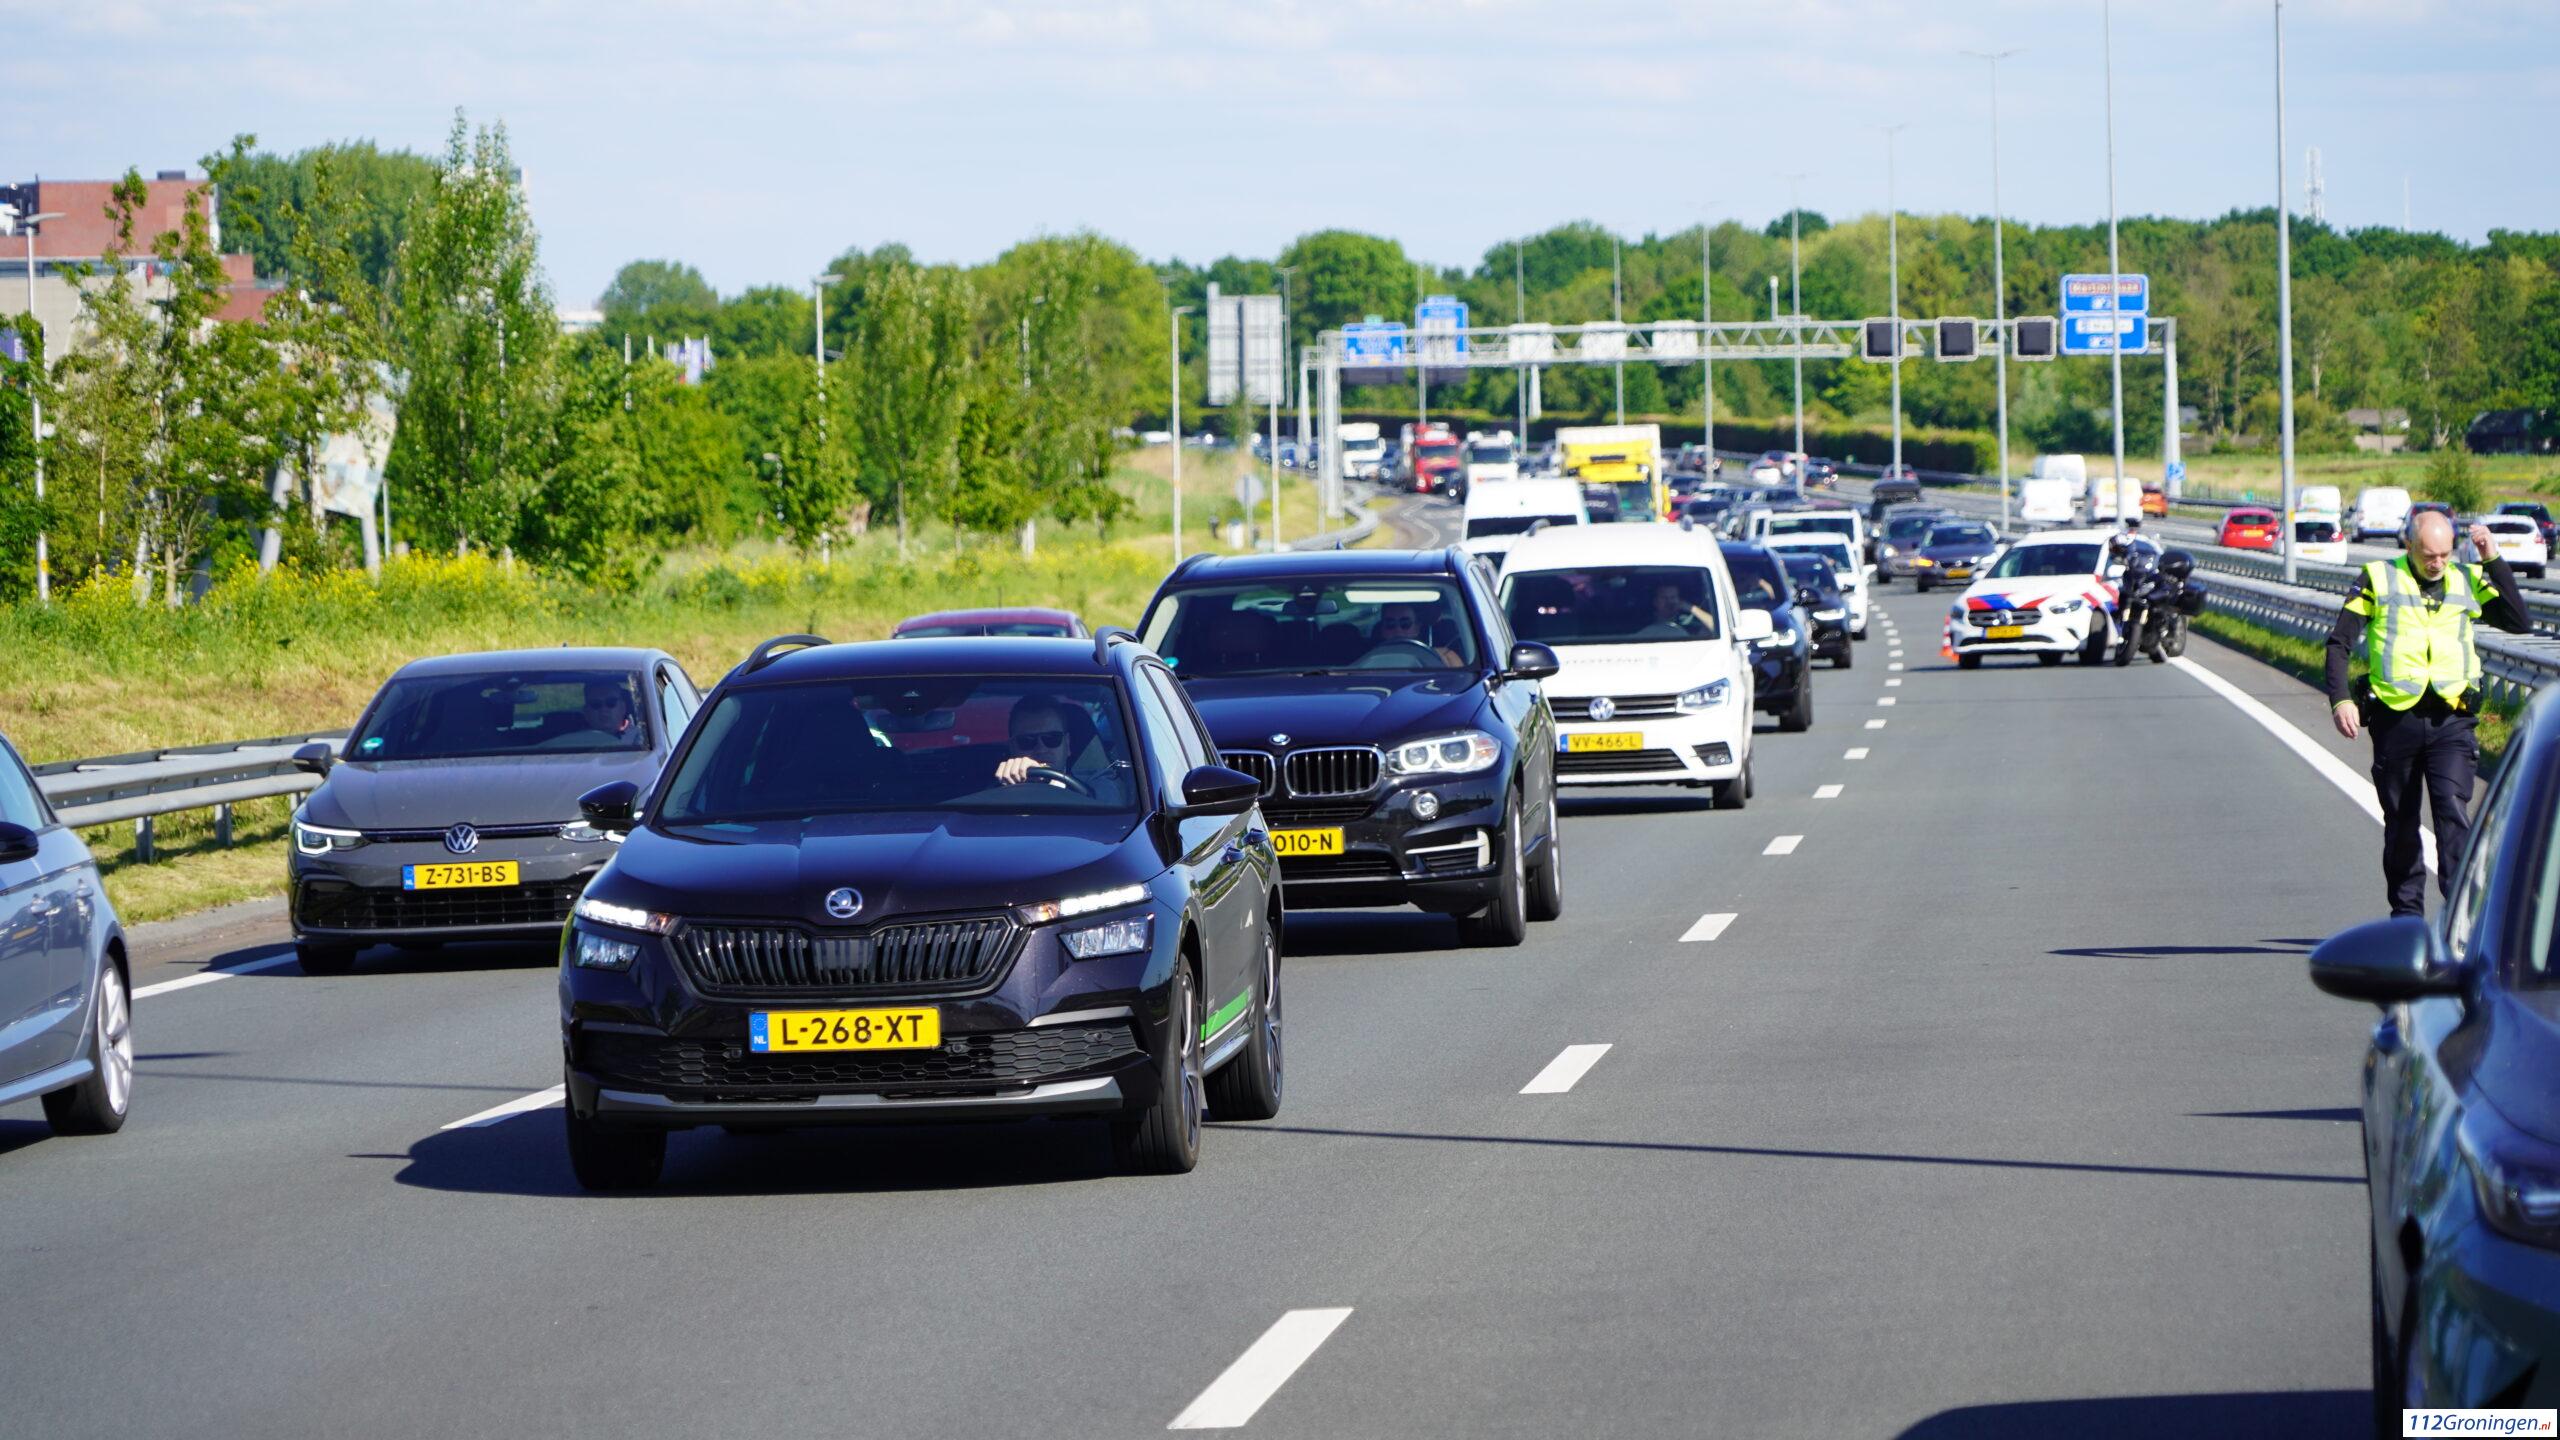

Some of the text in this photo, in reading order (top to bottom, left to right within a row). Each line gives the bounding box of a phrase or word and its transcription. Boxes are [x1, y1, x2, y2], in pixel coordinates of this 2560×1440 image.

[1572, 734, 1637, 748] VV-466-L
[425, 866, 506, 885] Z-731-BS
[754, 1015, 924, 1046] NL L-268-XT
